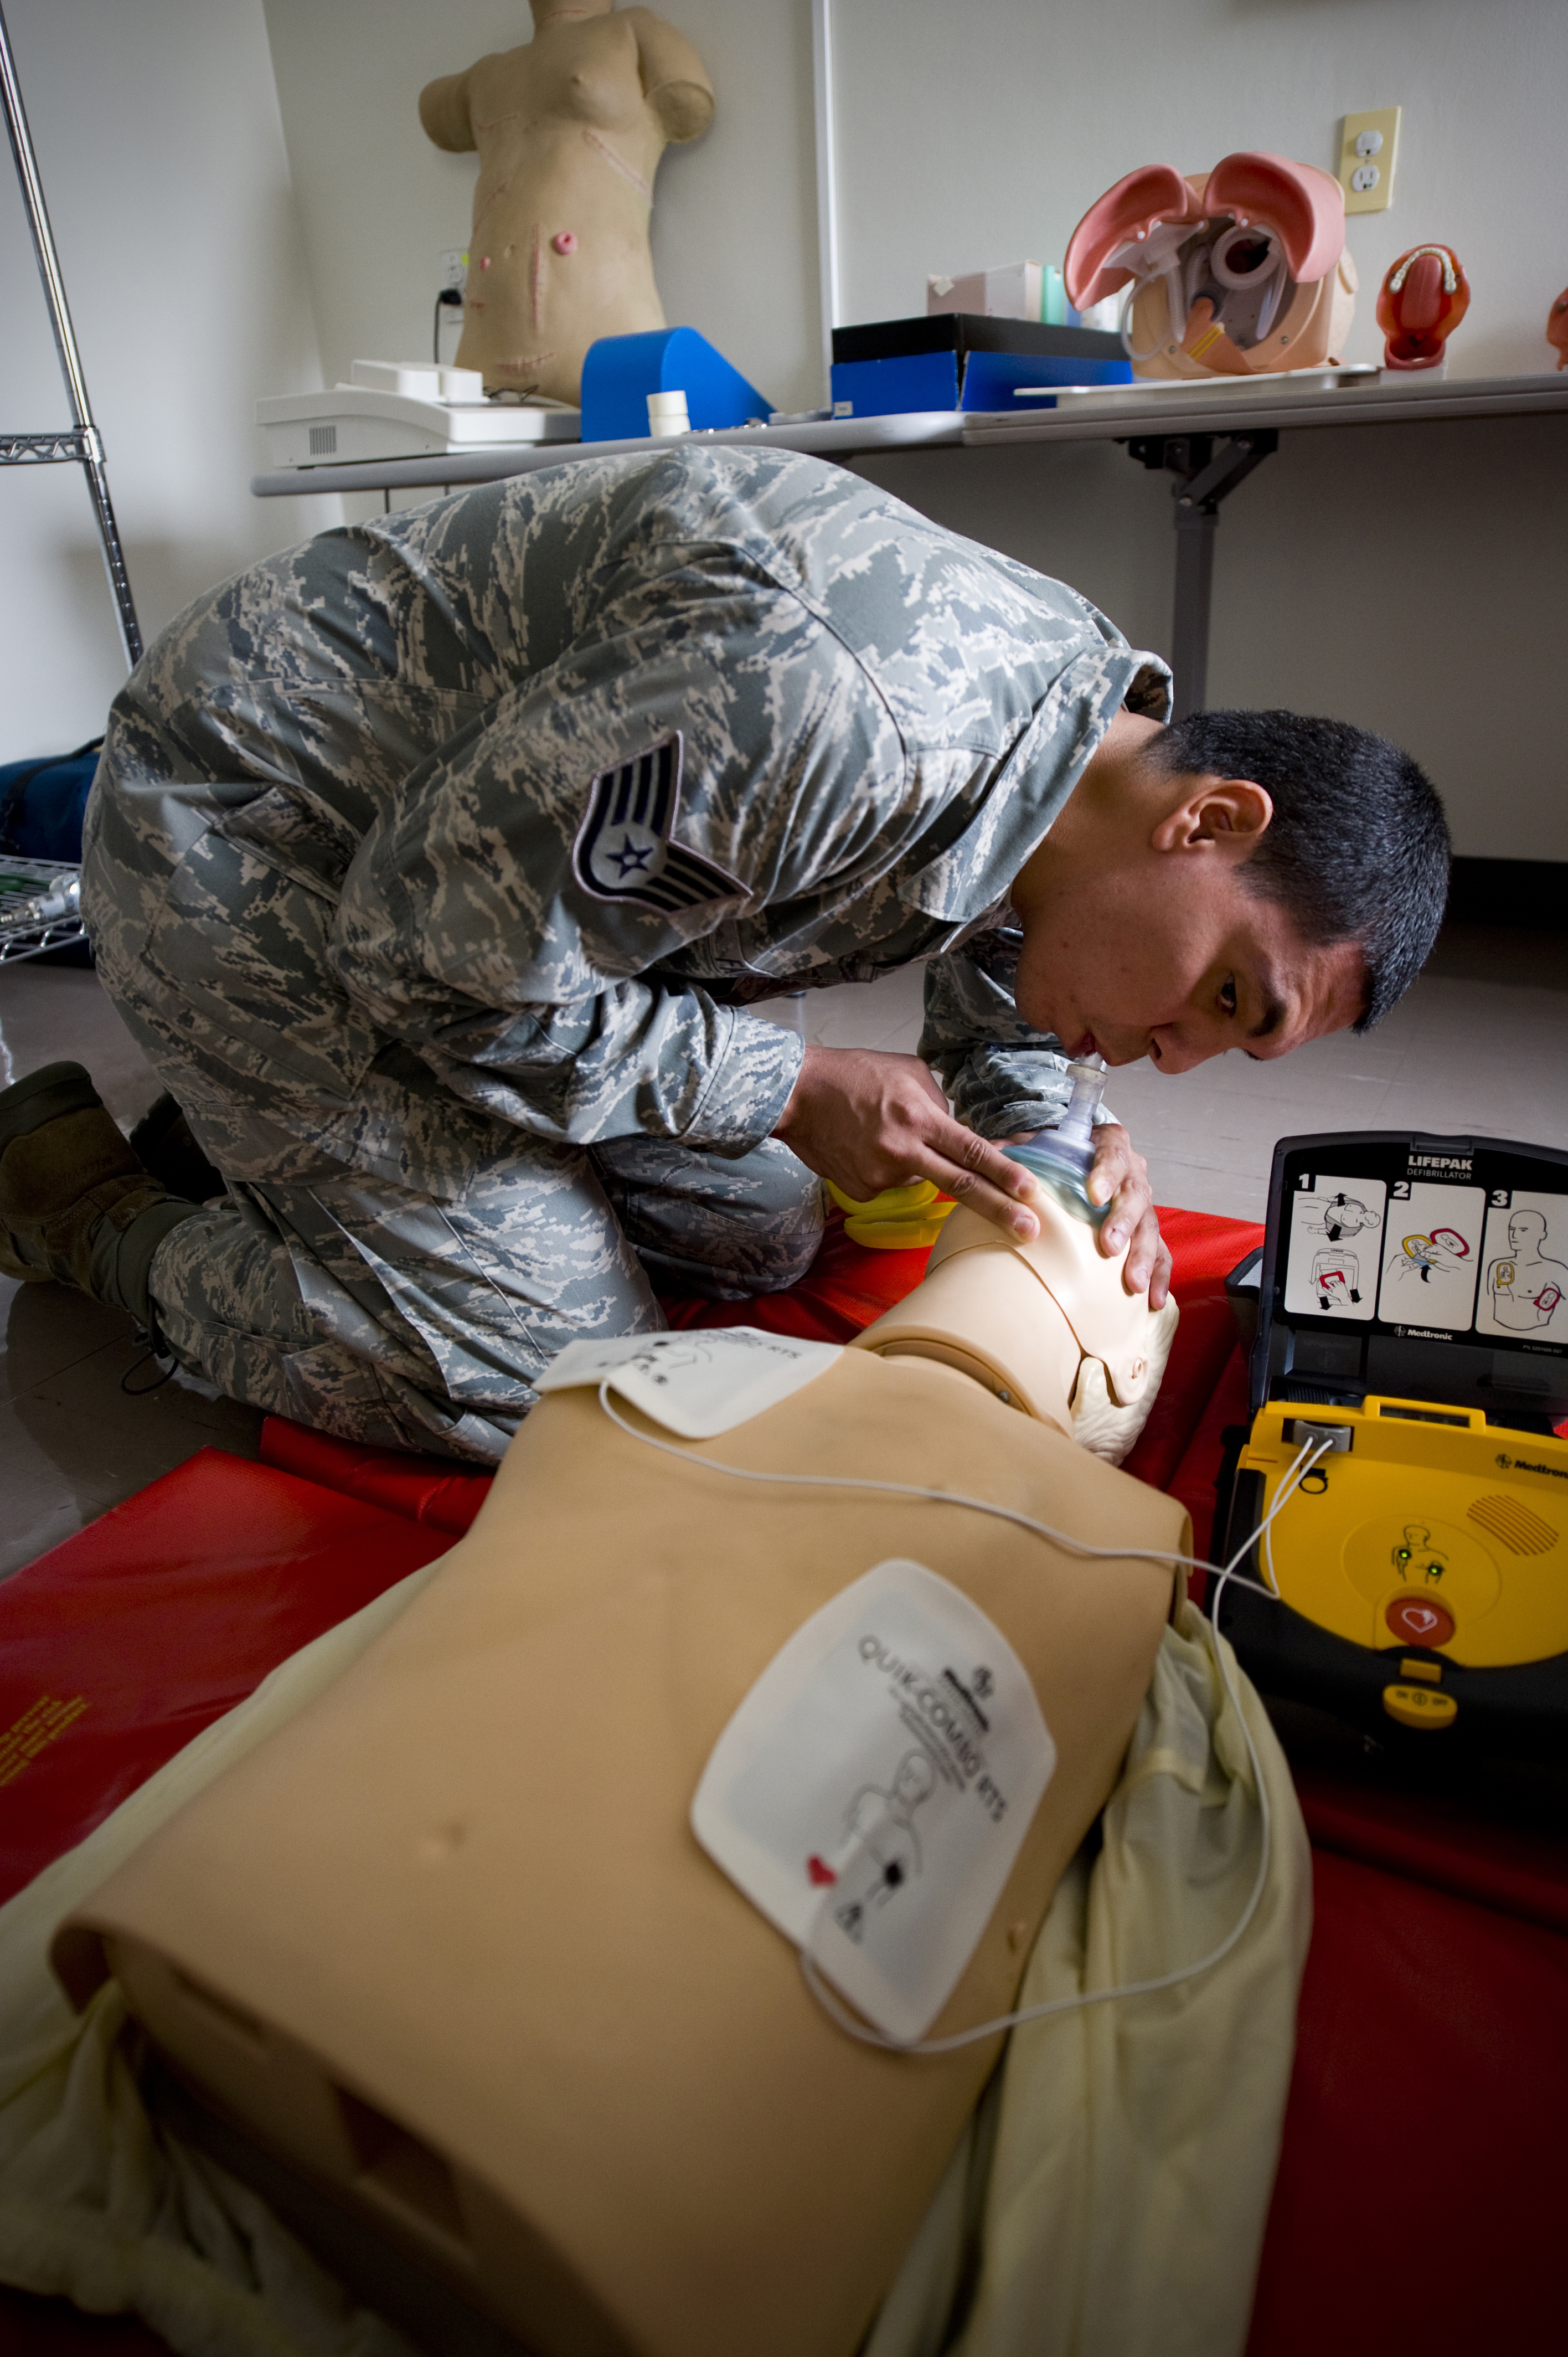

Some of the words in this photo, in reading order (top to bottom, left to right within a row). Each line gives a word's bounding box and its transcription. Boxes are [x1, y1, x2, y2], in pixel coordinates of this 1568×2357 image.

[1408, 1155, 1473, 1170] LIFEPAK
[1299, 1174, 1310, 1189] 1
[1407, 1168, 1472, 1180] DEFIBRILLATOR
[1393, 1181, 1410, 1197] 2
[1492, 1190, 1508, 1206] 3
[1407, 1329, 1453, 1341] Medtronic
